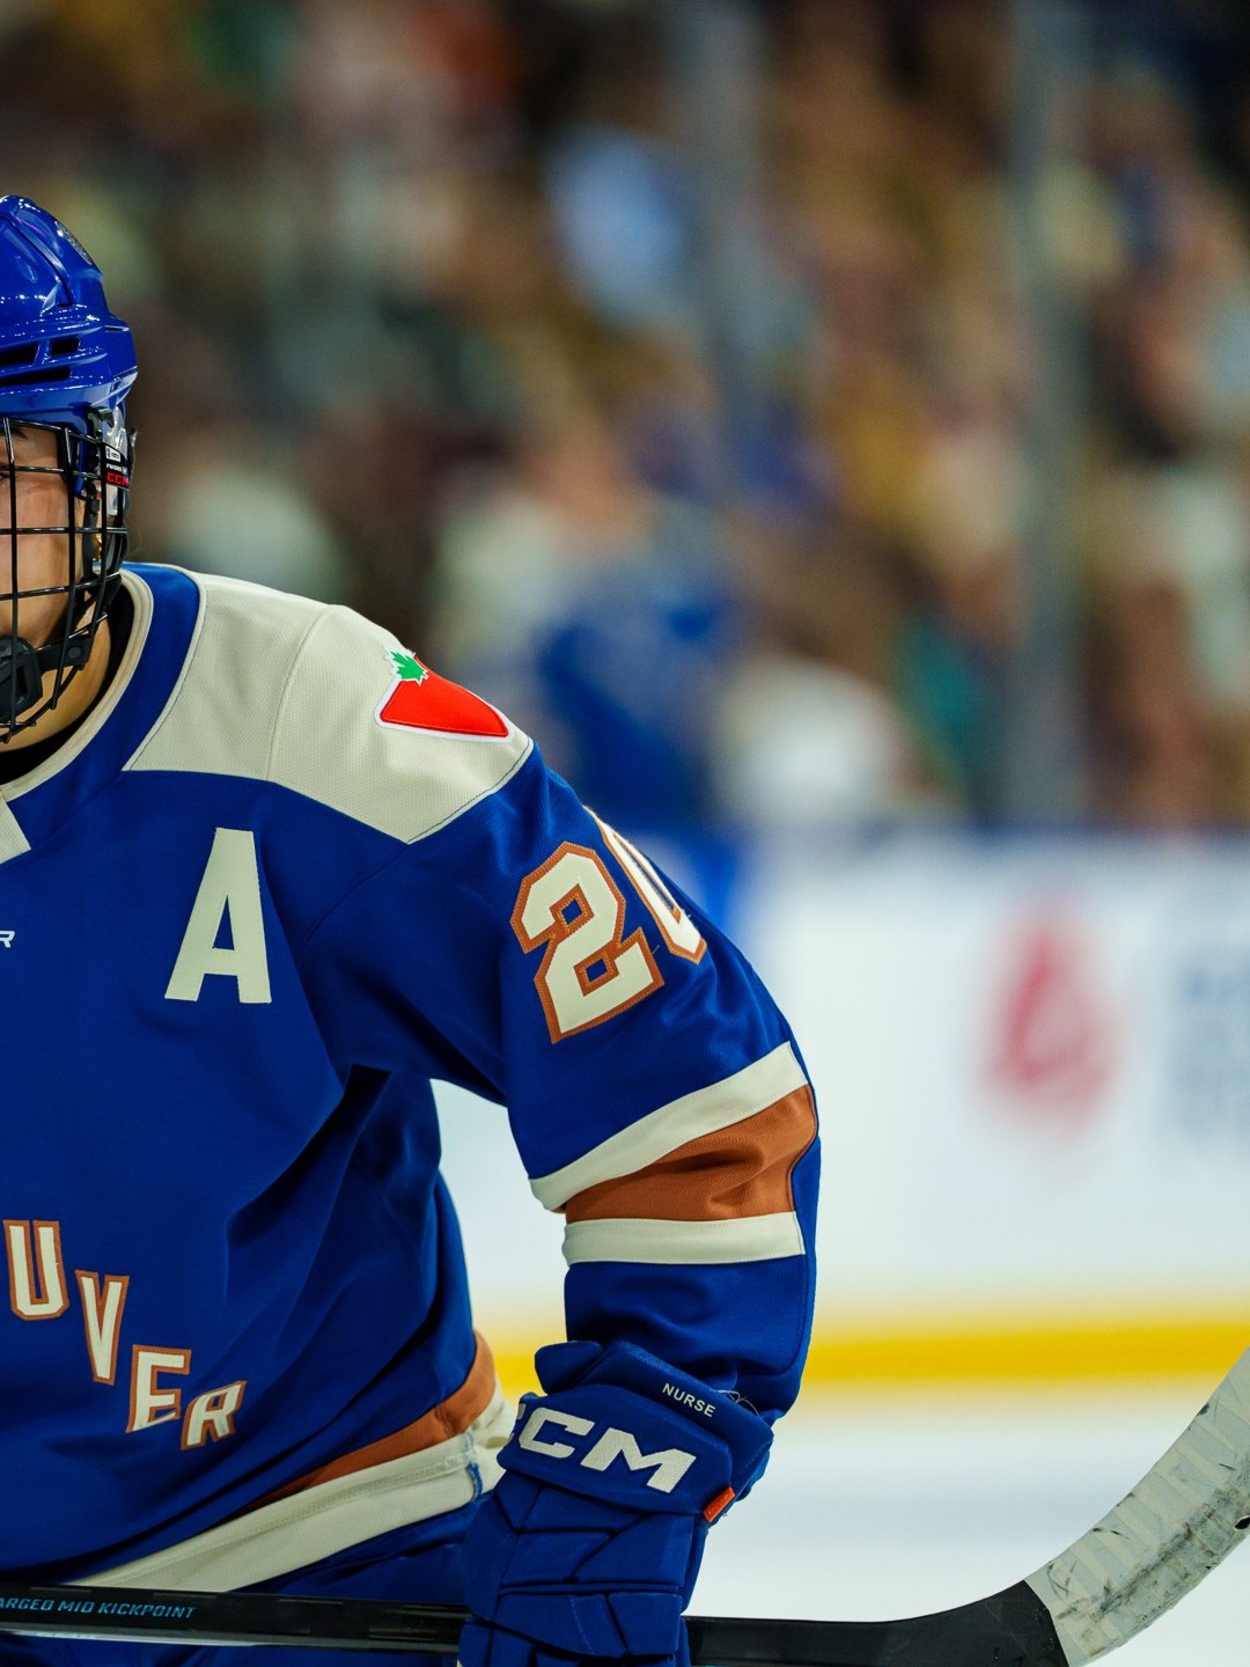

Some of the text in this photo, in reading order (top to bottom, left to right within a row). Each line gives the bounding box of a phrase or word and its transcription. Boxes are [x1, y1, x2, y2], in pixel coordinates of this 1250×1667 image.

[164, 827, 272, 1004] A
[510, 805, 708, 1044] 20
[661, 1383, 716, 1418] NURSE
[509, 1403, 697, 1493] CM
[57, 1600, 94, 1614] MID
[97, 1602, 197, 1619] KICKPOINT
